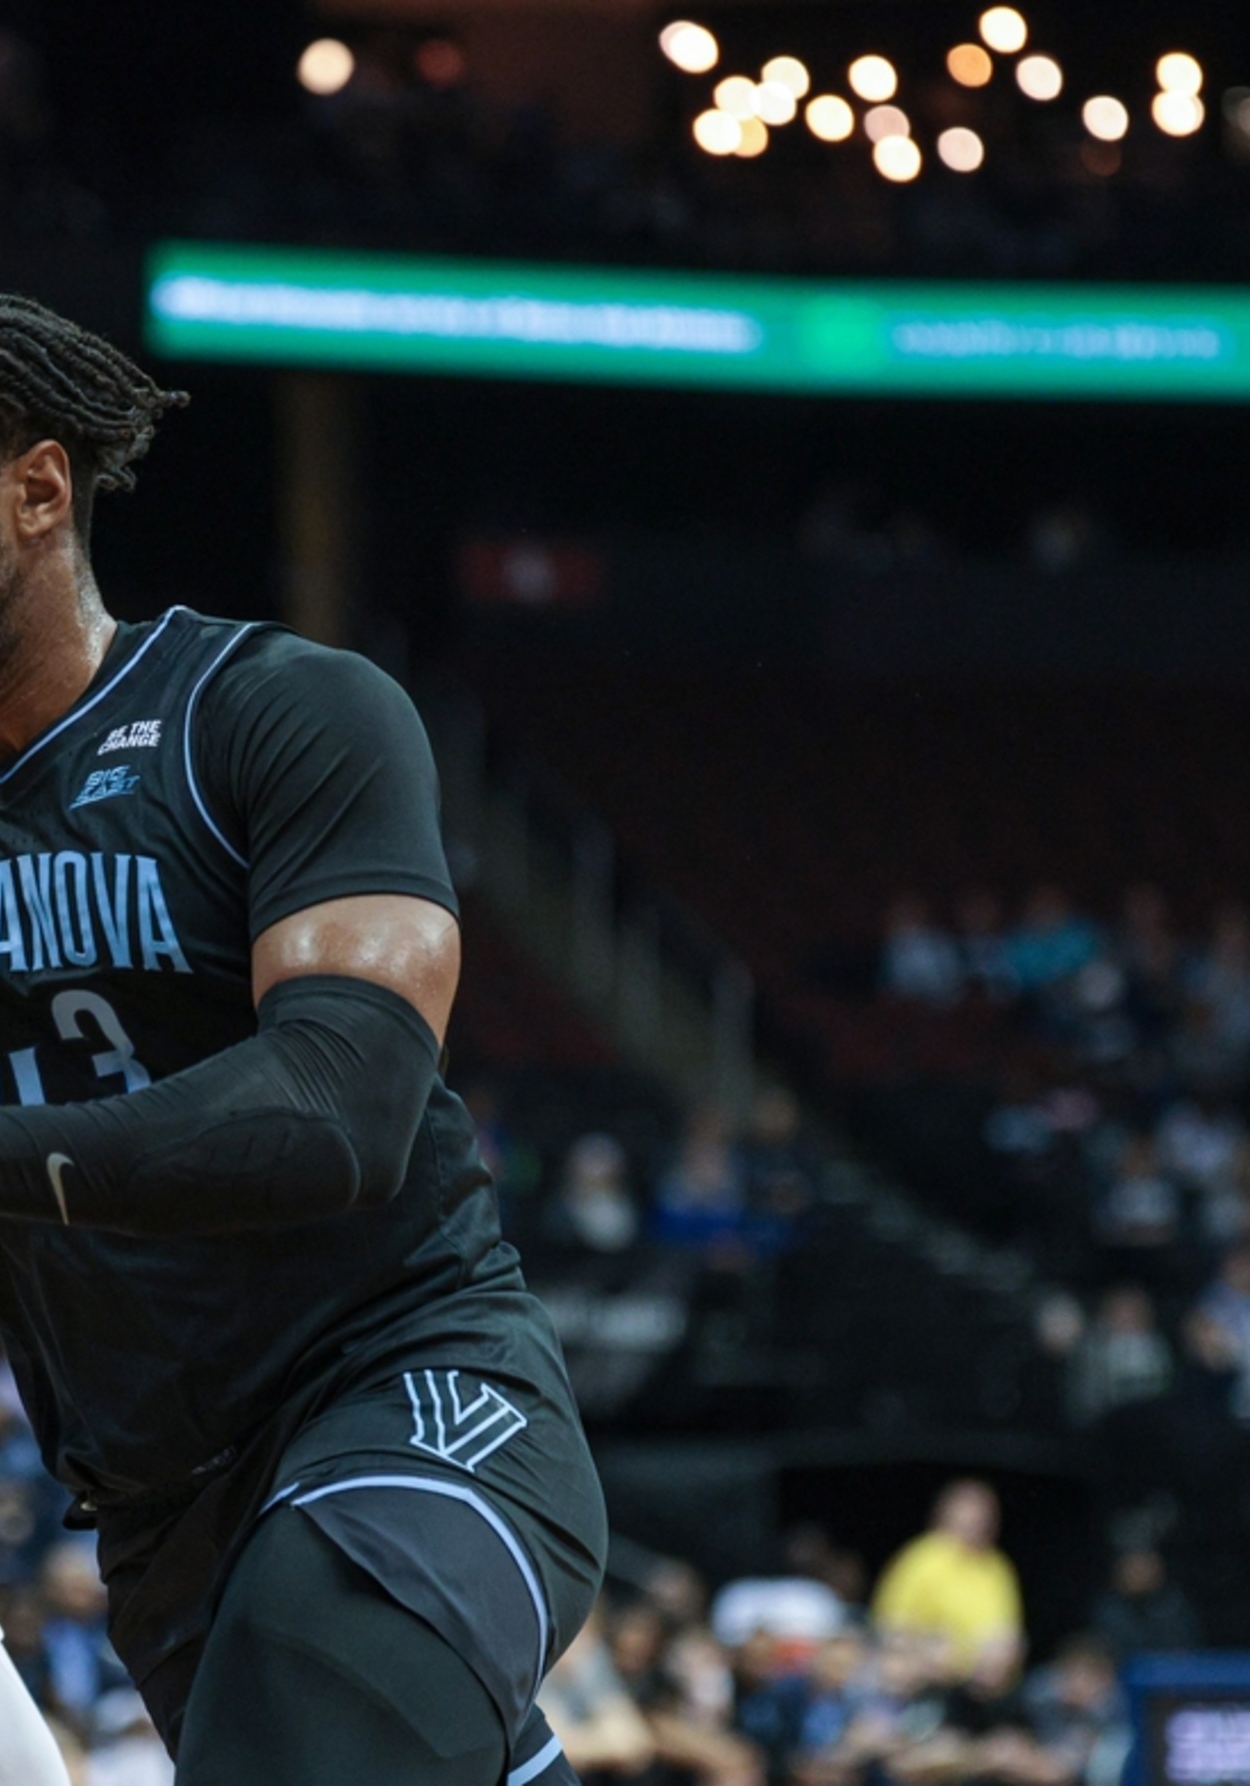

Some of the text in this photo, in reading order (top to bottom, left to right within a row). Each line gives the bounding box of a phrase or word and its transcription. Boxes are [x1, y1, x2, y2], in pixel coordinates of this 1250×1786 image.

[107, 719, 162, 740] BE THE
[96, 732, 162, 756] CHANGE
[86, 764, 131, 787] BIG
[73, 774, 141, 803] EAST
